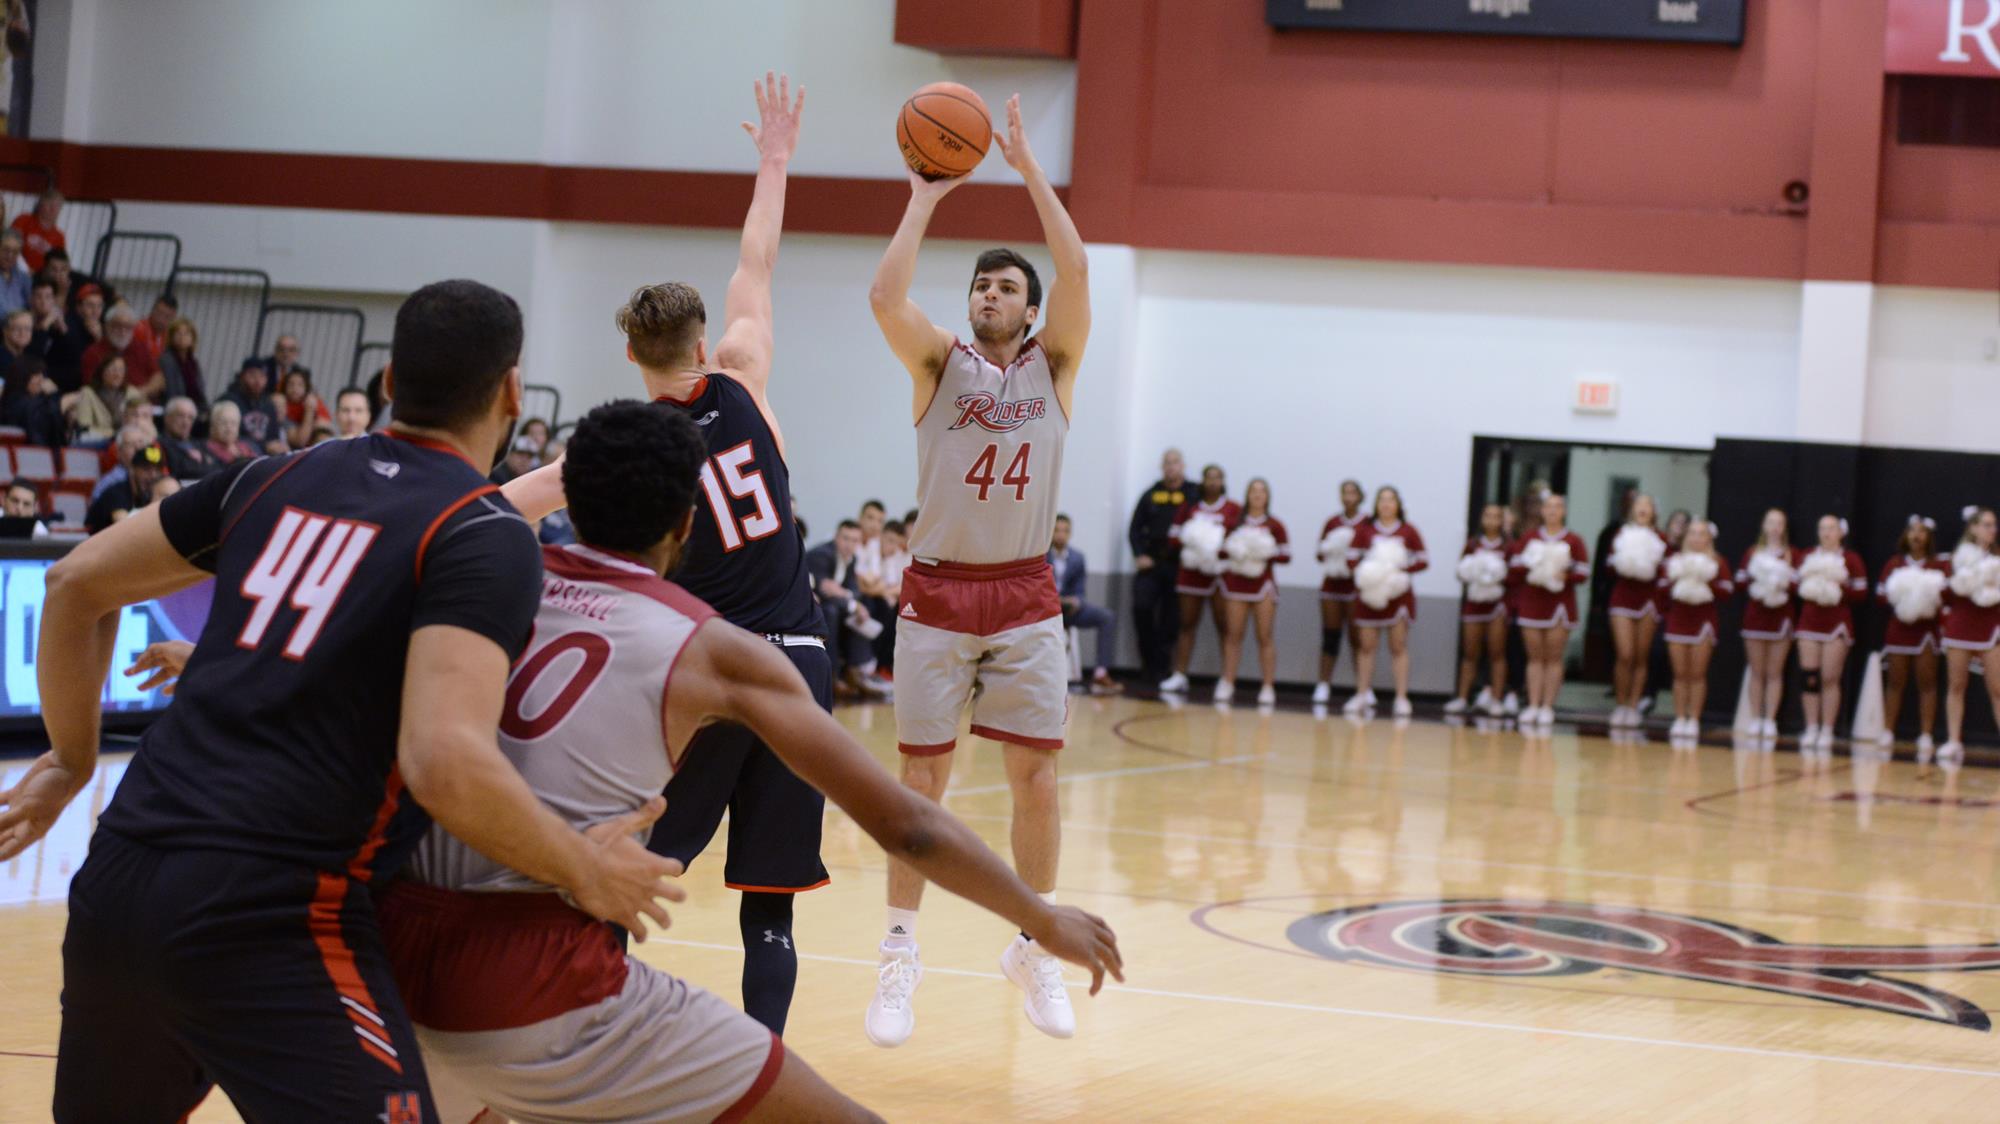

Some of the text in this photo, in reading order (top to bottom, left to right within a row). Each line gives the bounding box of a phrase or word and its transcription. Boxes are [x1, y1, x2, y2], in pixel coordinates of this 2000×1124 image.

[938, 132, 964, 153] ROCK
[699, 439, 782, 553] 15
[964, 442, 1032, 502] 44
[234, 504, 383, 662] 44
